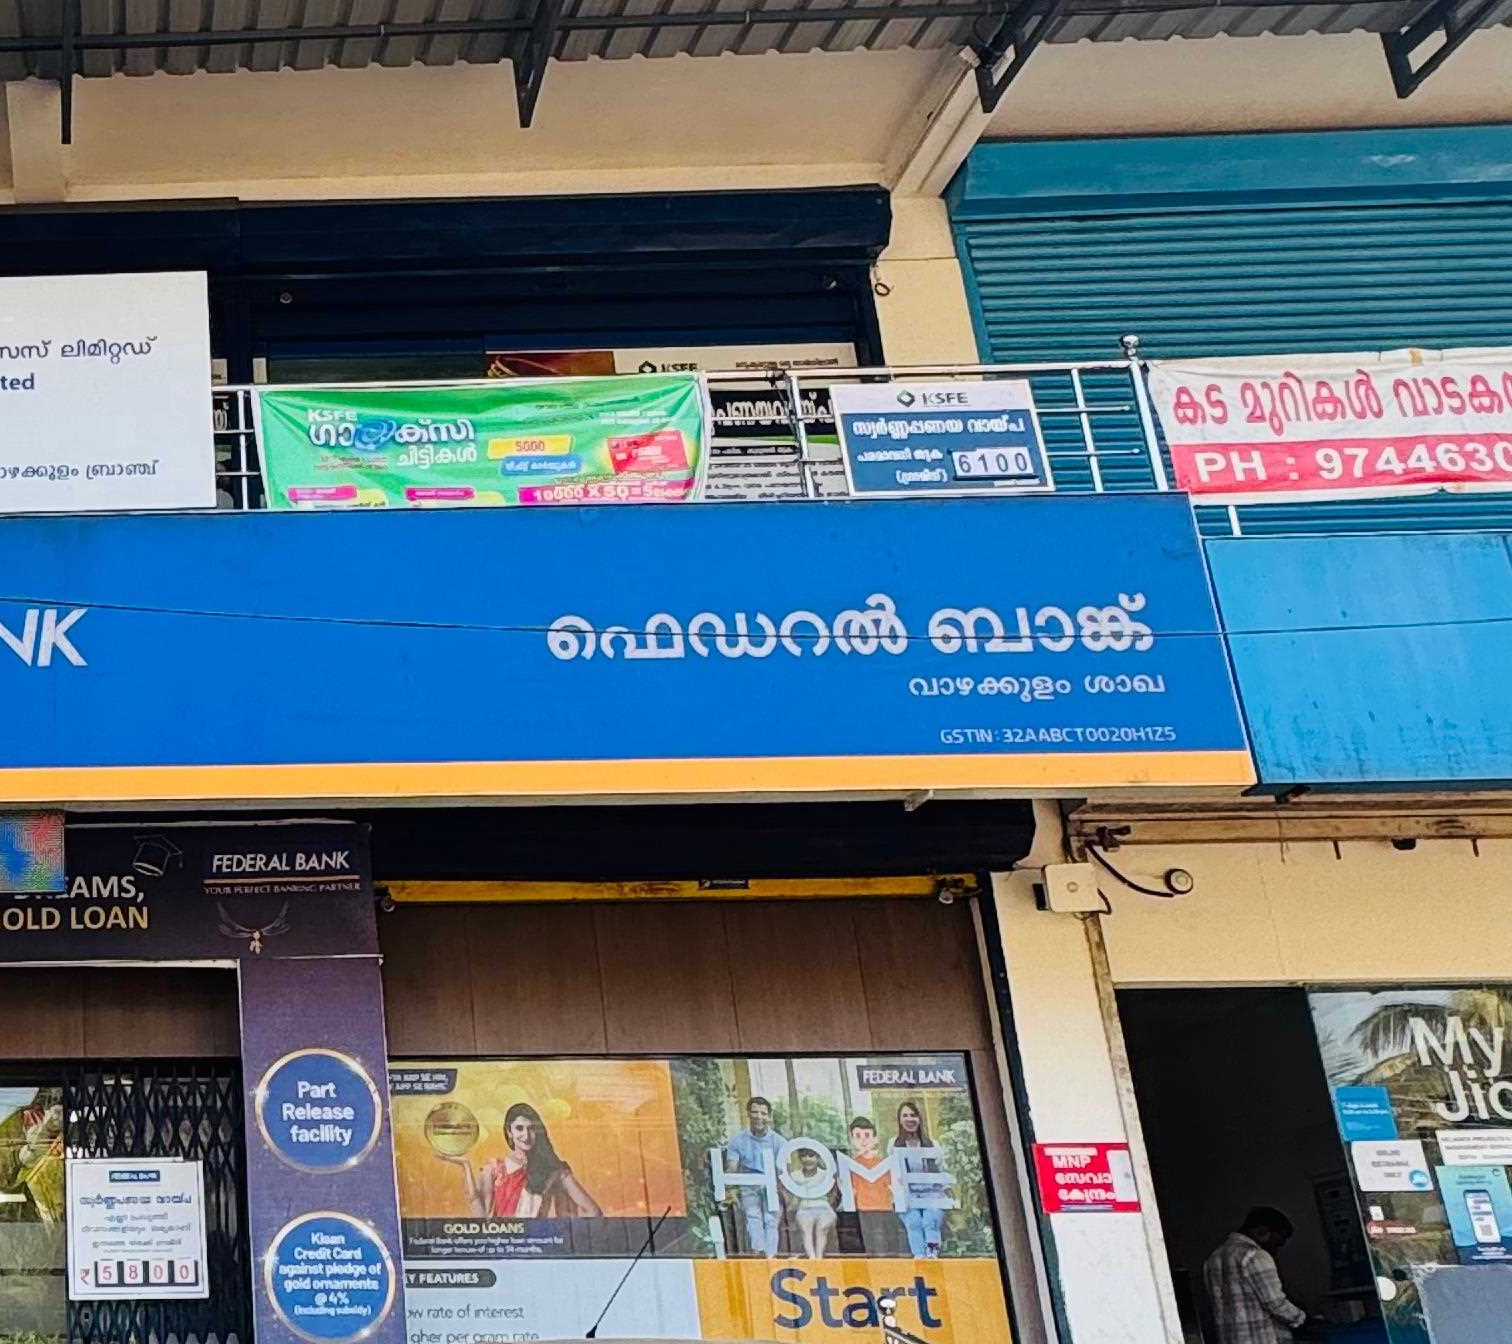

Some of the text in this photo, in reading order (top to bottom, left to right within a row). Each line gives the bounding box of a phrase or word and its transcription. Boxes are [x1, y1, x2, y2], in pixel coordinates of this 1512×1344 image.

[61, 335, 158, 364] ലിമിറ്റഡ്
[921, 392, 969, 404] KSFE
[1173, 383, 1229, 425] കട
[1240, 368, 1383, 436] മുറികൾ
[307, 408, 357, 422] KSFE
[959, 452, 1028, 474] 6100
[1195, 450, 1267, 482] PH
[547, 592, 1154, 660] ഫെഡറൽ ബാങ്ക്
[908, 674, 1166, 702] വാഴക്കുളം ശാഖ
[212, 851, 350, 873] FEDERAL BANK
[71, 906, 148, 929] LOAN
[1409, 1016, 1504, 1078] My
[863, 1070, 956, 1084] FEDERAL BANK
[297, 1081, 337, 1098] Part
[282, 1103, 355, 1121] Release
[290, 1124, 352, 1146] facility
[710, 1136, 962, 1212] HOME
[444, 1222, 525, 1234] GOLD LOANS
[294, 1247, 363, 1260] Credit Card
[102, 1264, 189, 1281] 5800
[279, 1262, 382, 1277] against pledge of
[420, 1273, 480, 1284] FEATURES
[284, 1277, 379, 1293] gold ornaments
[770, 1268, 942, 1329] Start
[427, 1306, 453, 1319] rate
[456, 1304, 471, 1319] of
[474, 1305, 524, 1319] interest
